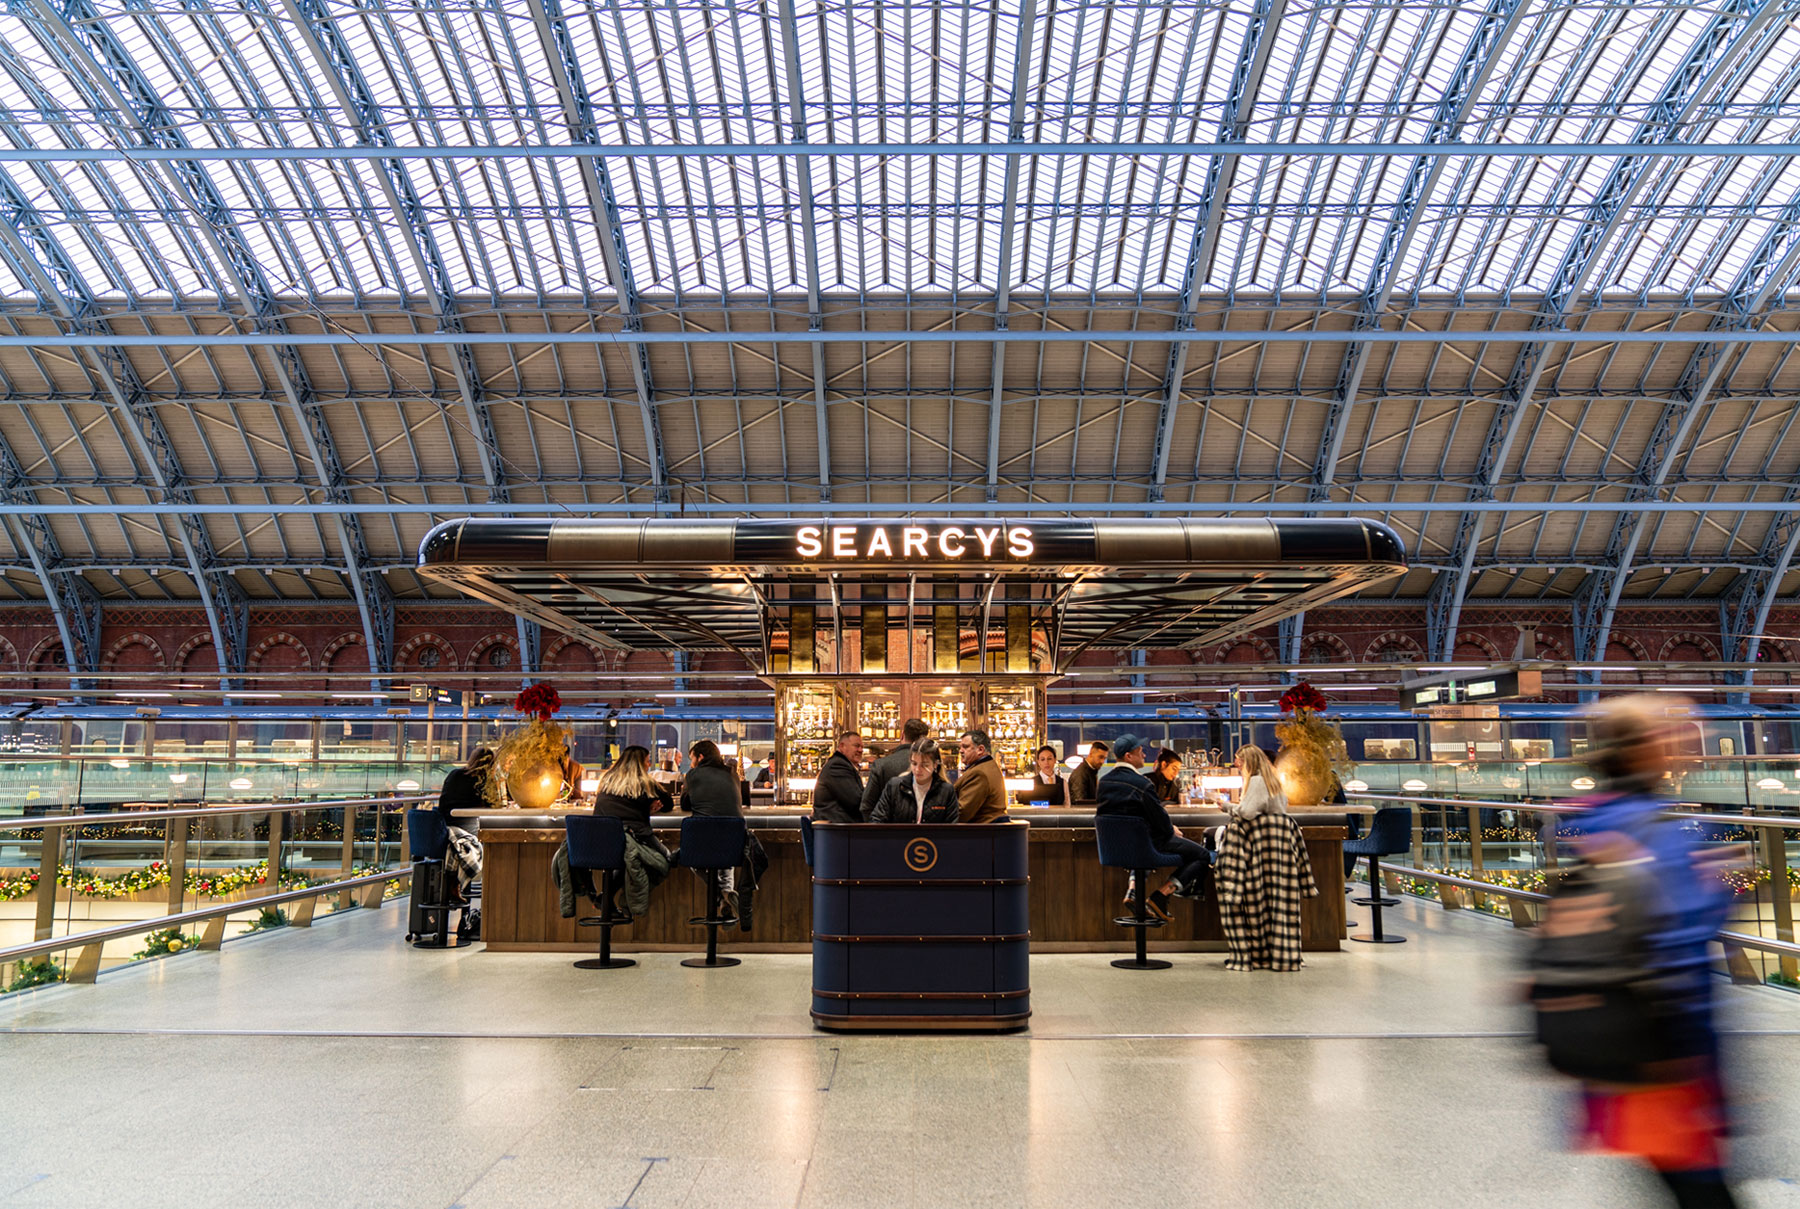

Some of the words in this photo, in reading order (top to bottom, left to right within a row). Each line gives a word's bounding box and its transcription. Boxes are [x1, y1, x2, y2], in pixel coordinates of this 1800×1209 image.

[796, 527, 1034, 557] SEARCYS
[415, 688, 422, 698] 5
[1482, 708, 1493, 733] 5
[913, 845, 929, 864] S
